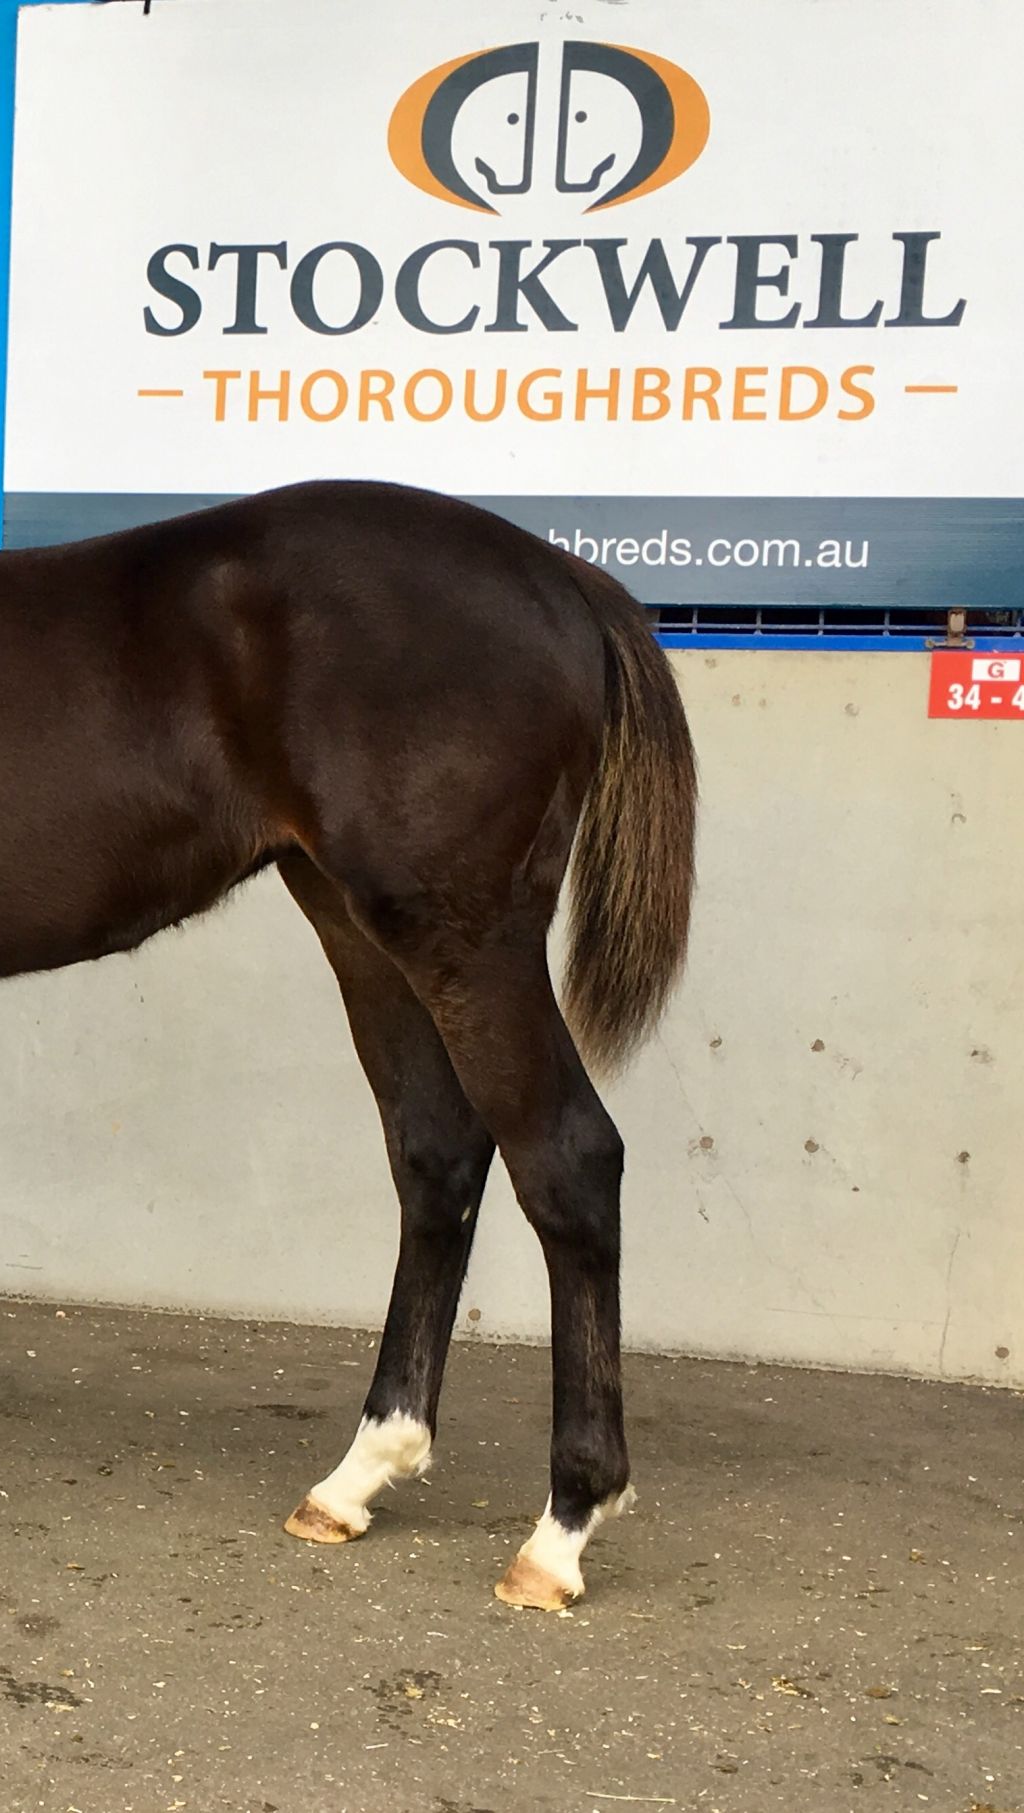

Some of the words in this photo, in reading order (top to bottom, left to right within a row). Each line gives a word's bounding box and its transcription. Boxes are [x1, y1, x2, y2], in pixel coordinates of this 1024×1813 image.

[143, 231, 967, 337] STOCKWELL
[202, 364, 876, 423] THOROUGHBREDS
[987, 662, 1005, 679] G
[947, 683, 981, 710] 34
